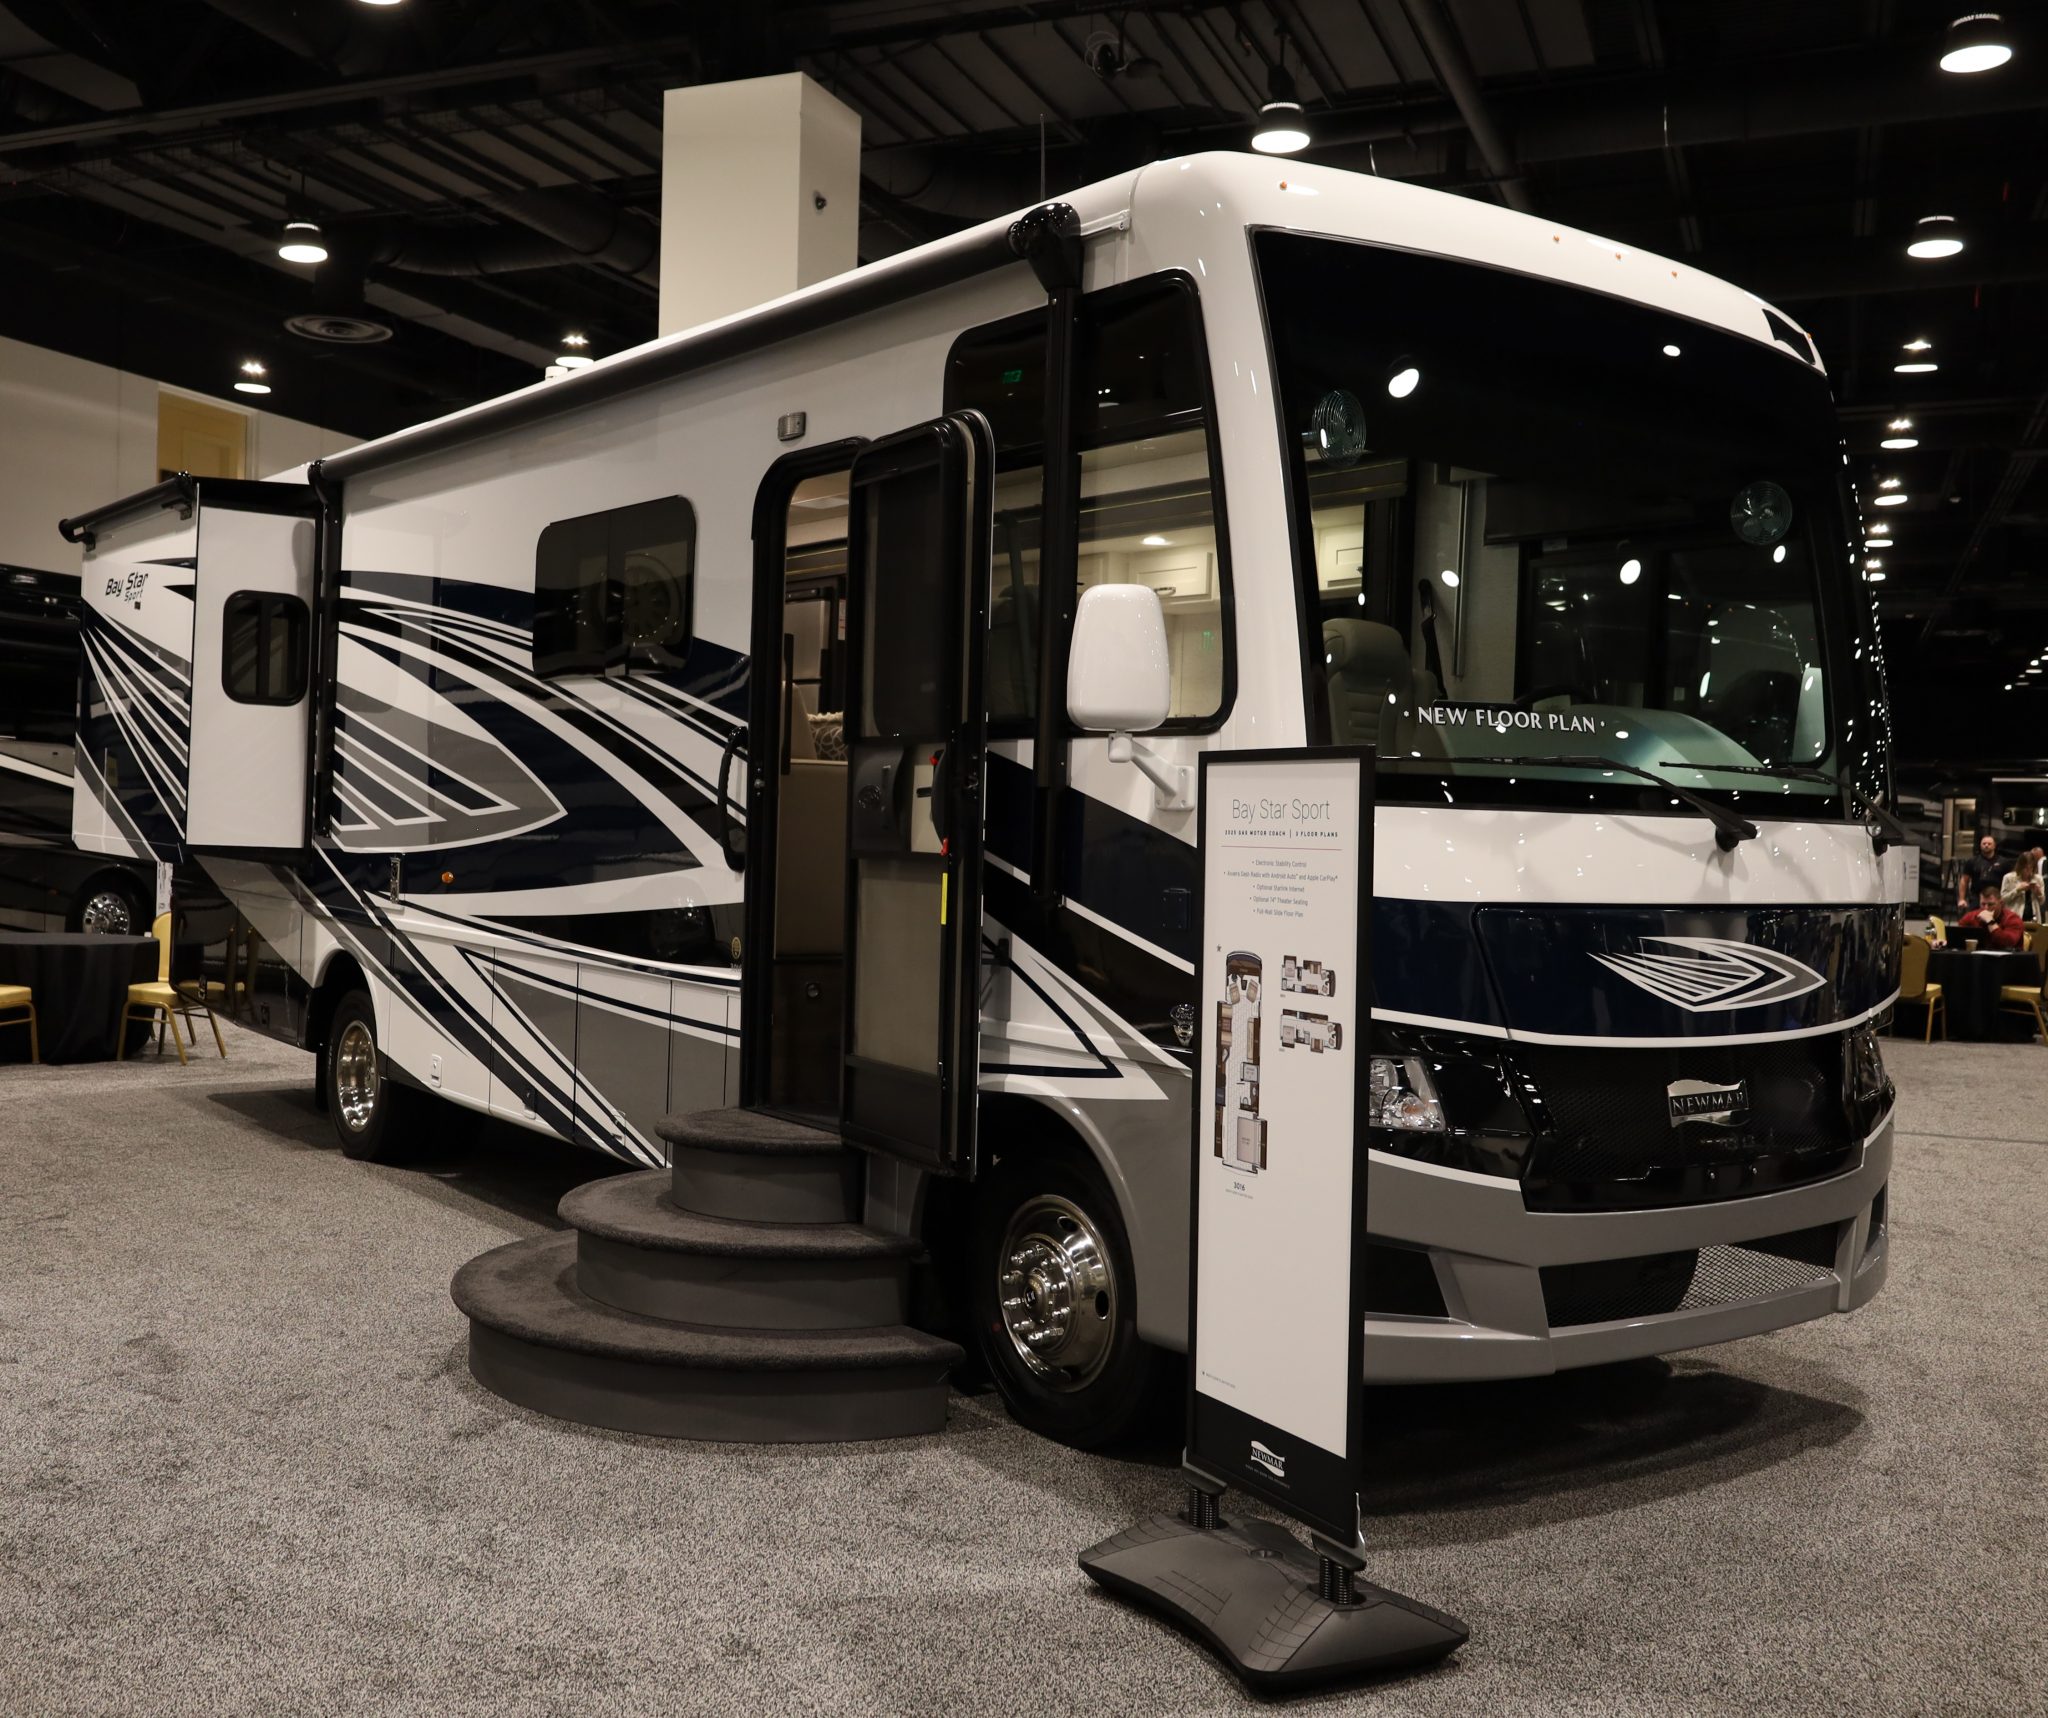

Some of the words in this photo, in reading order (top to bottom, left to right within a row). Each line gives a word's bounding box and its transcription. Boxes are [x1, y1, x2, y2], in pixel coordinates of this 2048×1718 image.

[105, 578, 125, 598] Bay
[126, 572, 149, 590] Star
[124, 589, 144, 603] Sport
[1418, 706, 1468, 726] NEW
[1475, 709, 1543, 729] FLOOR
[1549, 713, 1596, 733] PLAN
[1232, 799, 1256, 824] Bay
[1259, 798, 1287, 819] Star
[1292, 798, 1331, 824] Sport
[1275, 860, 1291, 868] Stability
[1672, 1091, 1744, 1116] NEWMAR
[1252, 1447, 1284, 1470] NEWMAR
